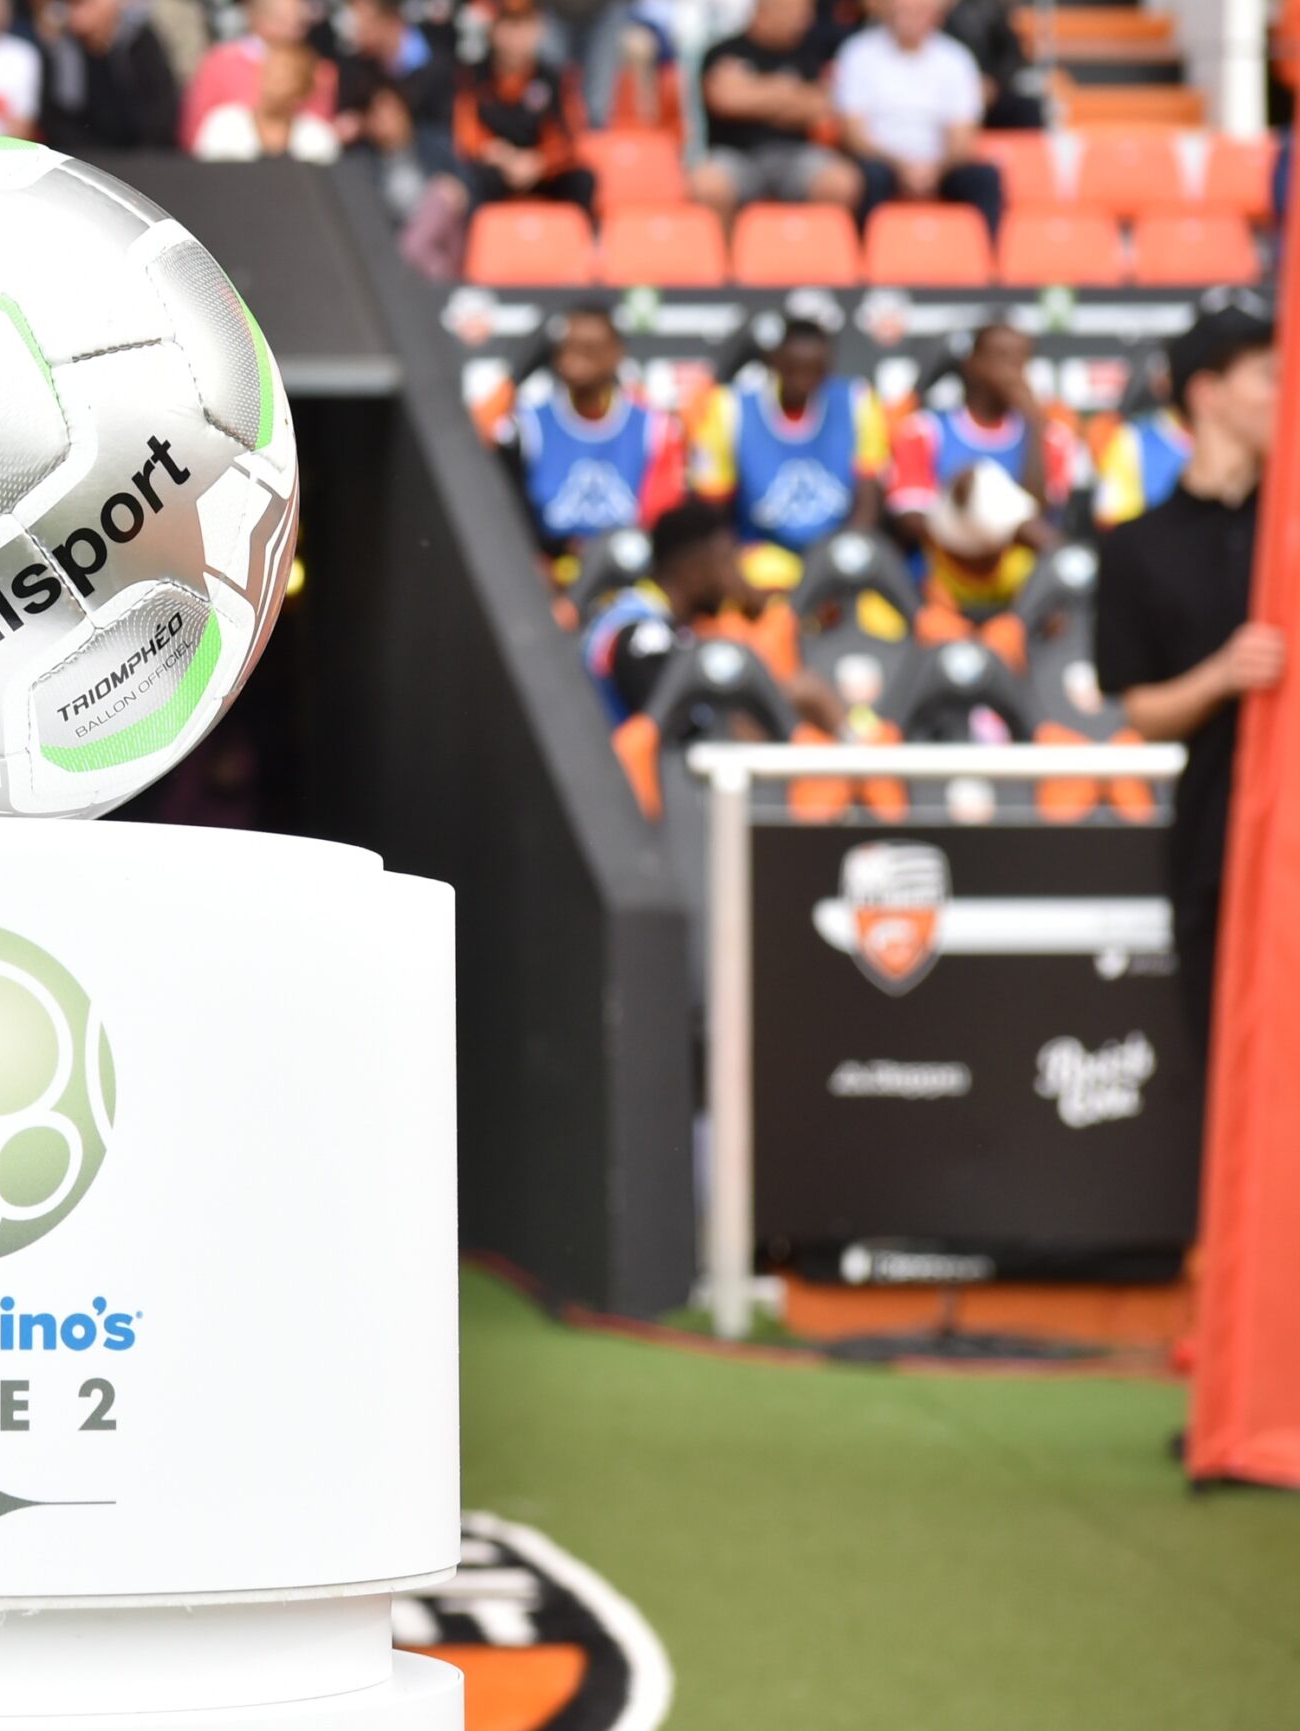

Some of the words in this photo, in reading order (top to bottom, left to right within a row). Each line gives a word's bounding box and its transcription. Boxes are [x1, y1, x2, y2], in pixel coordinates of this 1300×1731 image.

[57, 612, 183, 722] TRIOMPHÉO
[75, 691, 137, 738] BALLON
[138, 640, 193, 694] OFFICIEL
[78, 1377, 117, 1431] 2
